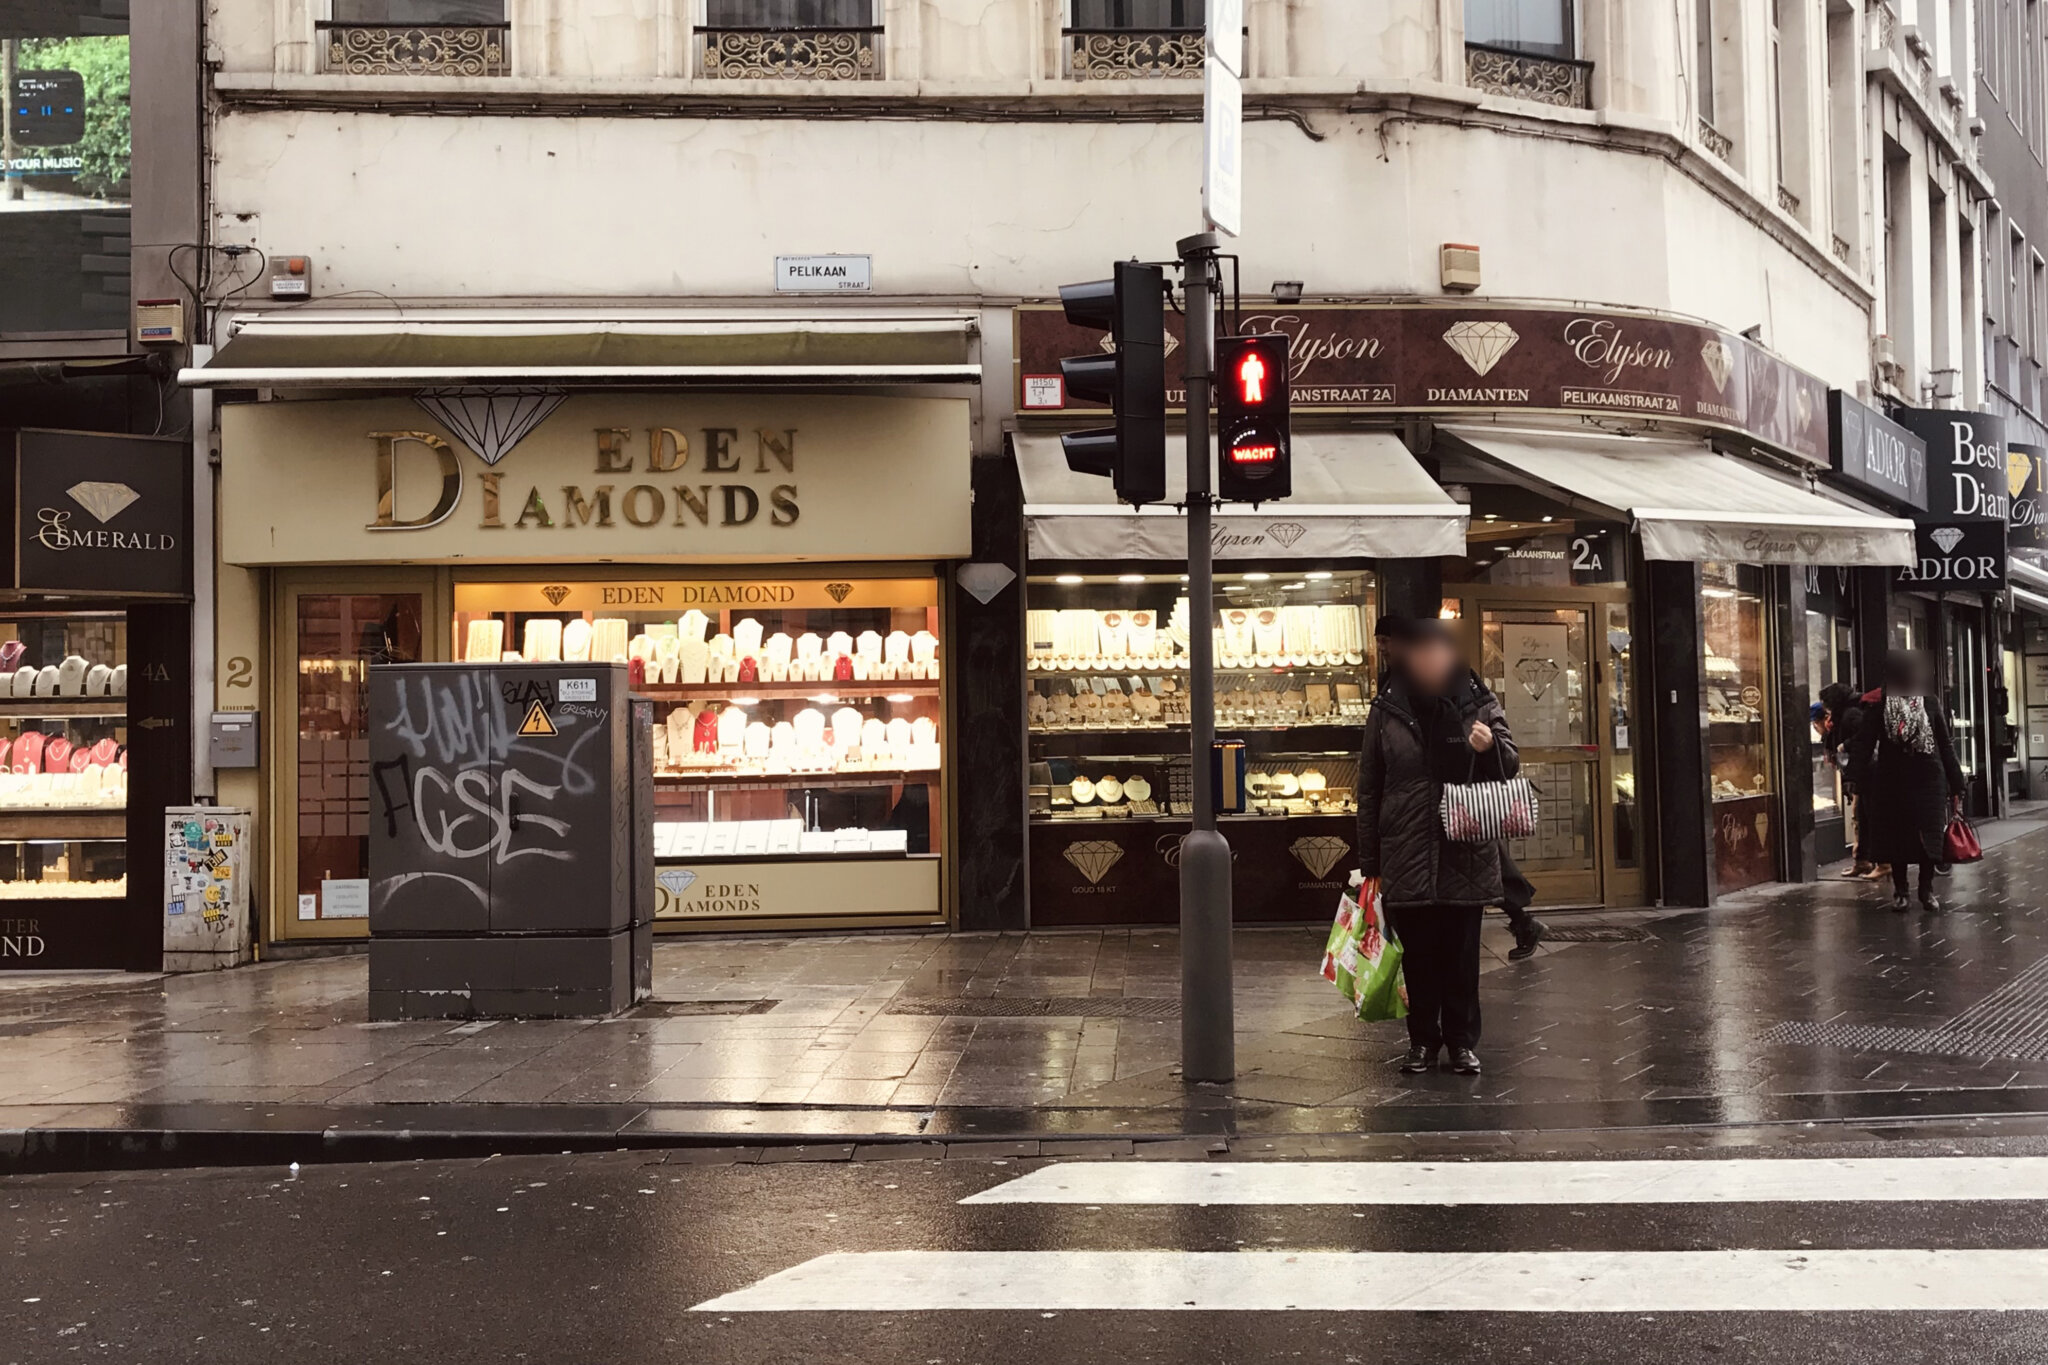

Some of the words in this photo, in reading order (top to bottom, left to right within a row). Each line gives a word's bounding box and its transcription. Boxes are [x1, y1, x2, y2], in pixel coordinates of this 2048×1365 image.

[8, 159, 41, 169] YOUR
[789, 266, 847, 277] PELIKAAN
[1564, 318, 1674, 385] Elyson
[1033, 378, 1054, 386] H150
[1373, 388, 1392, 401] 2A
[1428, 388, 1529, 402] DIAMANTEN
[1563, 390, 1663, 409] PELIKAANSTRAAT
[1665, 397, 1679, 411] 2A
[594, 426, 798, 474] EDEN
[1233, 447, 1275, 460] WACHT
[1867, 424, 1908, 488] ADIOR
[1950, 421, 2001, 470] Best
[365, 430, 801, 530] DIAMONDS
[29, 508, 175, 550] EMERALD
[1211, 523, 1265, 555] lyson
[1572, 538, 1602, 571] 2A
[1897, 556, 1999, 581] ADIOR
[601, 585, 665, 605] EDEN
[682, 584, 795, 604] DIAMOND
[142, 663, 170, 681] 4A
[226, 656, 253, 688] 2
[567, 682, 588, 690] K611
[705, 884, 759, 897] EDEN
[1072, 886, 1095, 894] GOUD
[1107, 885, 1116, 893] KT
